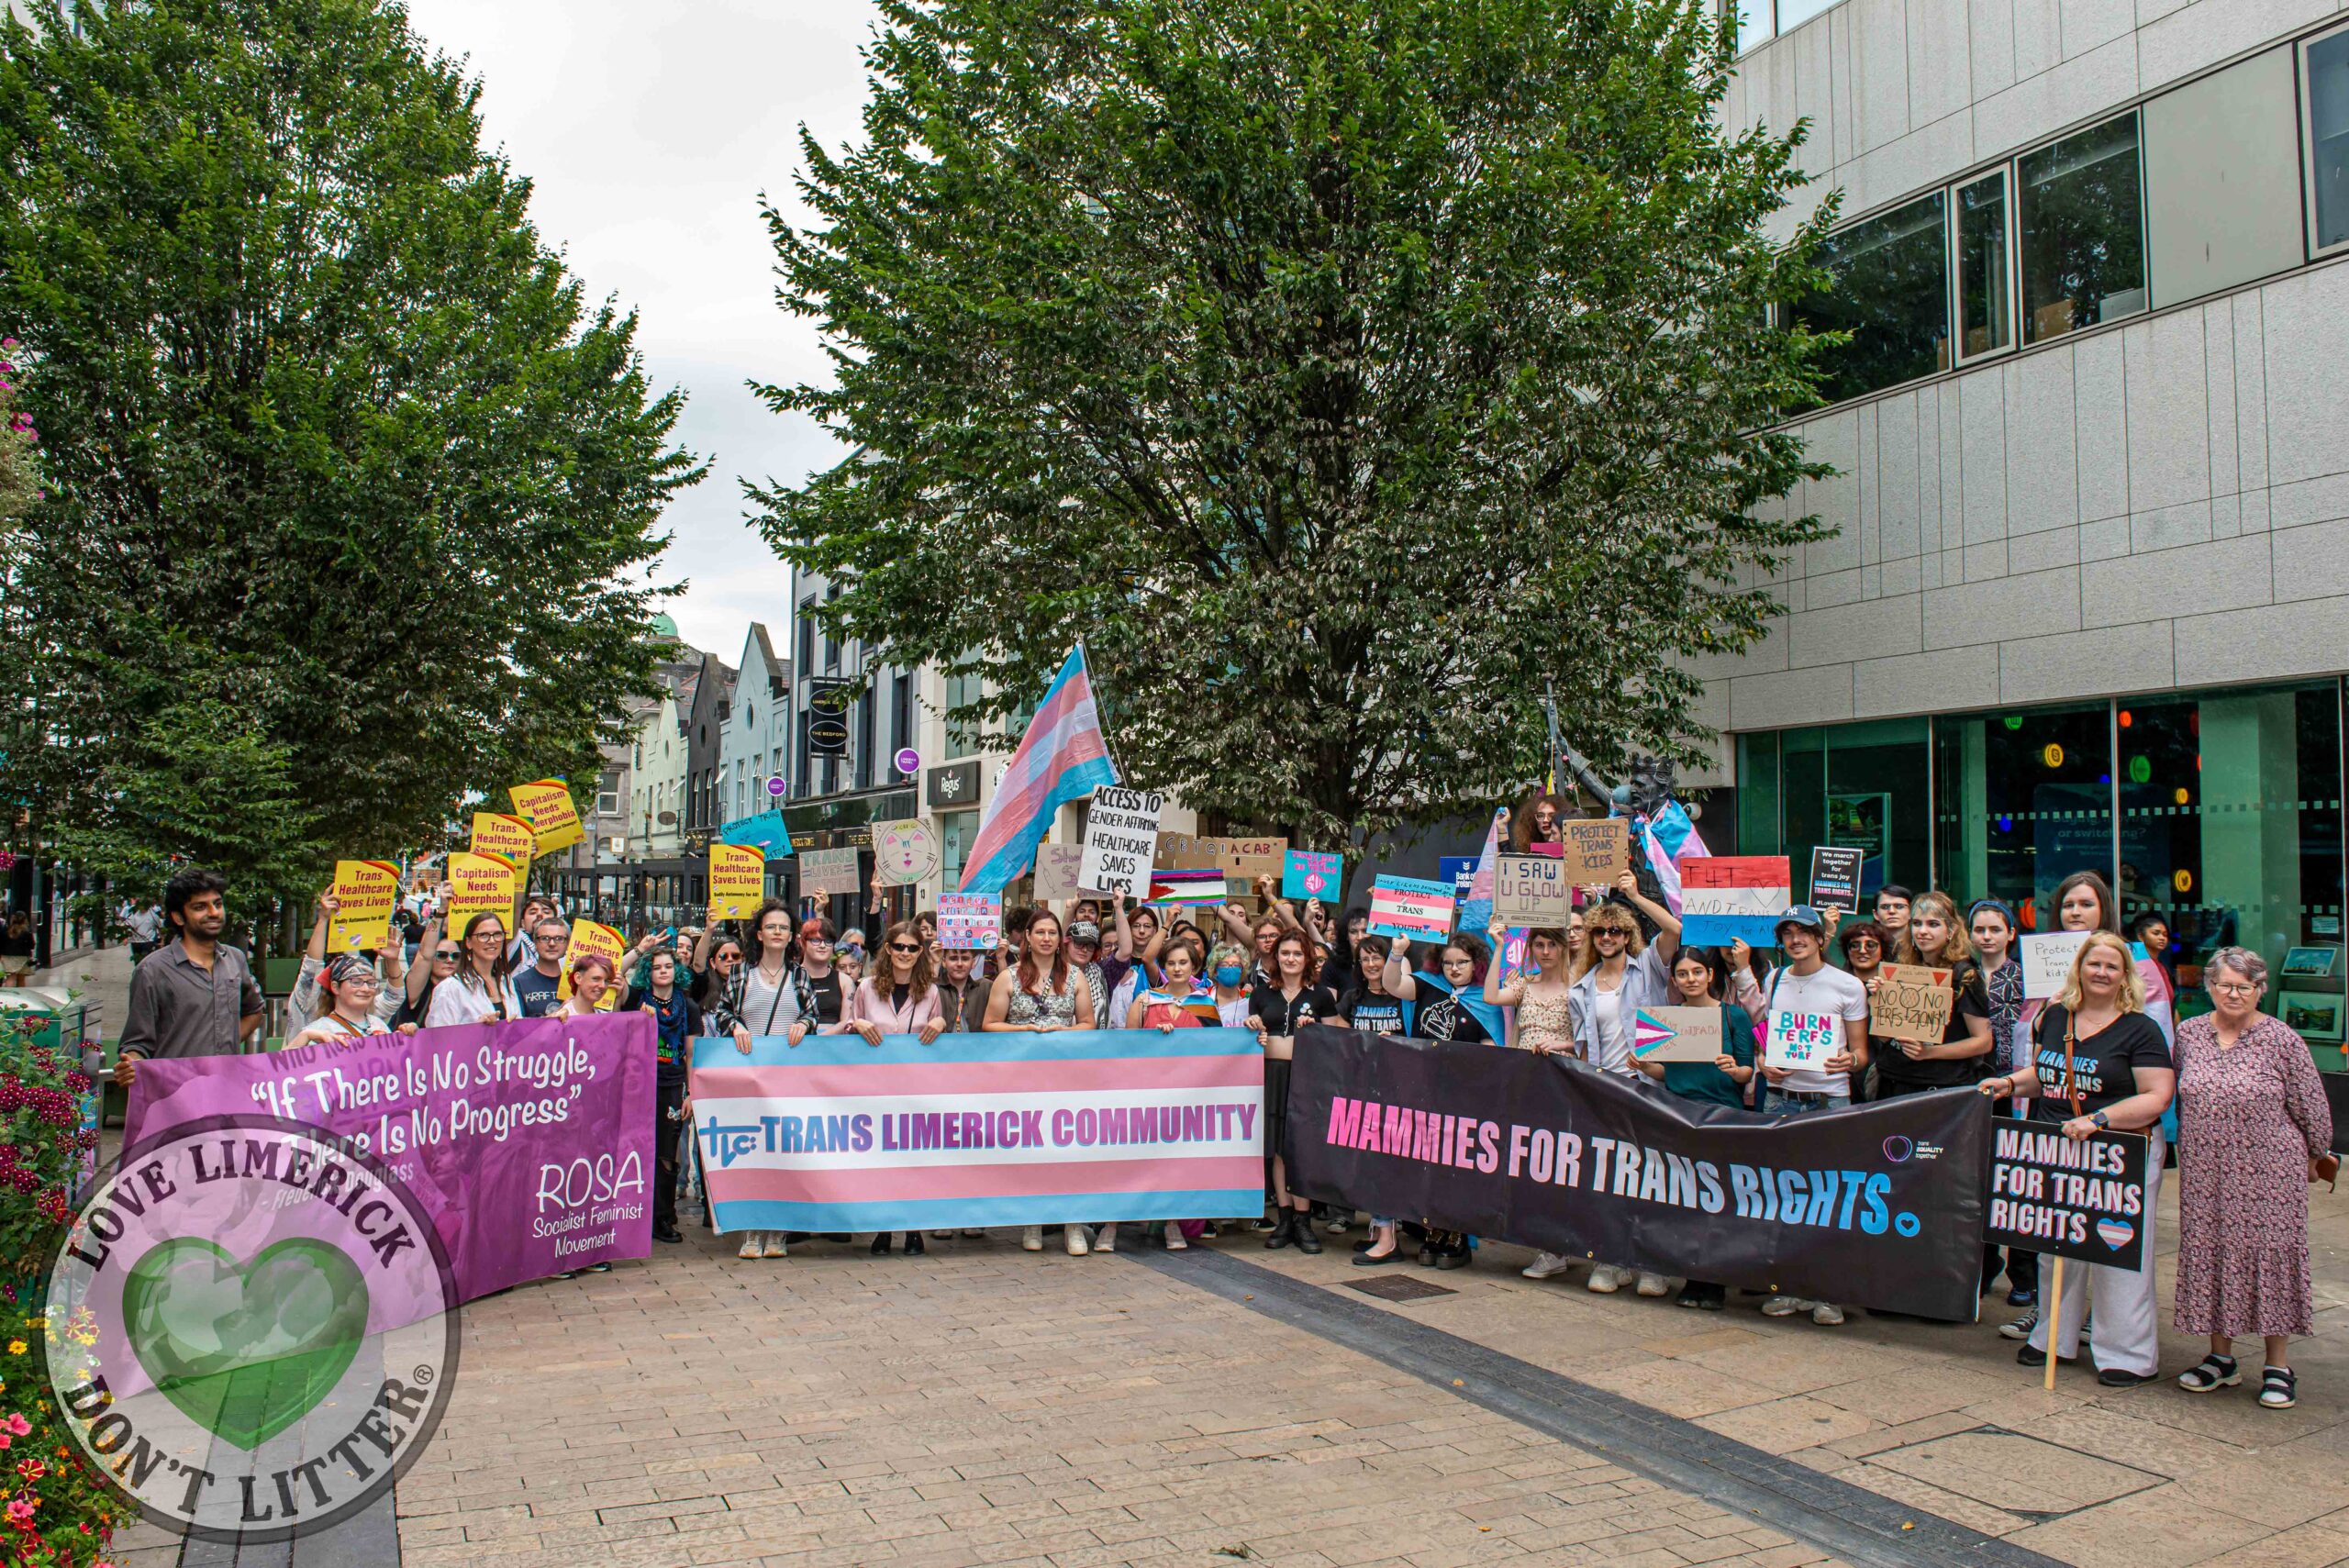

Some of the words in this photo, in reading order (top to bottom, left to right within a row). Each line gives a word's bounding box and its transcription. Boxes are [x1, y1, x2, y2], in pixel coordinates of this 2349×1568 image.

[941, 776, 961, 798] Regus
[519, 791, 565, 808] Capitalism
[1092, 786, 1141, 811] ACCESS
[1144, 793, 1161, 813] TO
[532, 804, 559, 817] Needs
[534, 809, 575, 828] eerphobia
[723, 817, 753, 835] PROTECT
[1088, 808, 1123, 827] GENDER
[1124, 815, 1159, 832] AFFIRMING
[491, 822, 517, 833] Trans
[1571, 825, 1620, 840] PROTECT
[476, 833, 528, 846] Healthcare
[1092, 831, 1152, 857] HEALTHCARE
[1156, 837, 1226, 855] GBTQI
[1578, 840, 1613, 853] TRANS
[725, 852, 749, 862] Trans
[765, 845, 785, 859] HTS!
[801, 849, 854, 866] TRANS
[713, 863, 761, 873] Healthcare
[1100, 854, 1135, 874] SAVES
[1584, 854, 1613, 869] KIDS
[355, 871, 383, 881] Trans
[455, 868, 509, 880] Capitalism
[810, 864, 843, 877] LIVES
[1456, 872, 1469, 880] Bank
[1519, 862, 1556, 880] SAW
[467, 882, 497, 891] Needs
[713, 875, 737, 884] Saves
[739, 875, 761, 884] Lives
[1097, 874, 1131, 895] LIVES
[339, 884, 393, 895] Healthcare
[1394, 888, 1432, 899] PROTECT
[1501, 880, 1512, 896] U
[1518, 881, 1564, 898] GLOW
[365, 896, 391, 907] Lives
[452, 894, 512, 906] Queerphobia
[1520, 897, 1540, 911] UP
[1685, 897, 1721, 915] AND
[1816, 900, 1849, 908] #LoveWins
[1397, 905, 1424, 916] TRANS
[1392, 922, 1422, 933] YOUTH
[1703, 920, 1732, 936] JOY
[589, 930, 612, 944] Trans
[573, 940, 619, 959] Healthcare
[2035, 942, 2077, 955] Protect
[2041, 956, 2069, 966] Trans
[2046, 969, 2067, 978] kids
[1878, 990, 1897, 1006] NO
[1923, 992, 1943, 1009] NO
[1355, 1006, 1397, 1018] MAMMIES
[1354, 1018, 1371, 1030] FOR
[1372, 1018, 1402, 1031] TRANS
[1780, 1012, 1831, 1031] BURN
[1774, 1028, 1833, 1046] TERFS
[1789, 1043, 1812, 1051] NOT
[1785, 1051, 1811, 1060] TURF
[304, 1067, 400, 1114] There
[406, 1057, 428, 1097] Is
[432, 1051, 469, 1092] No
[474, 1038, 596, 1089] Struggle,
[2038, 1067, 2055, 1084] OR
[2059, 1072, 2102, 1093] TANS
[760, 1114, 874, 1154] TRANS
[882, 1109, 1044, 1152] LIMERICK
[1052, 1104, 1257, 1148] COMMUNITY
[281, 1129, 371, 1177] There
[381, 1114, 406, 1155] Is
[411, 1106, 441, 1149] No
[1326, 1096, 1500, 1174] MAMMIES
[1508, 1124, 1583, 1187] FOR
[1591, 1136, 1726, 1214] TRANS
[1996, 1128, 2125, 1175] MAMMIES
[345, 1162, 414, 1193] Douglass
[535, 1151, 645, 1213] ROSA
[1993, 1163, 2043, 1201] FOR
[2051, 1172, 2142, 1217] TRANS
[532, 1215, 585, 1239] Socialist
[590, 1203, 643, 1225] Feminist
[1990, 1198, 2087, 1244] RIGHTS
[555, 1229, 616, 1258] Movement
